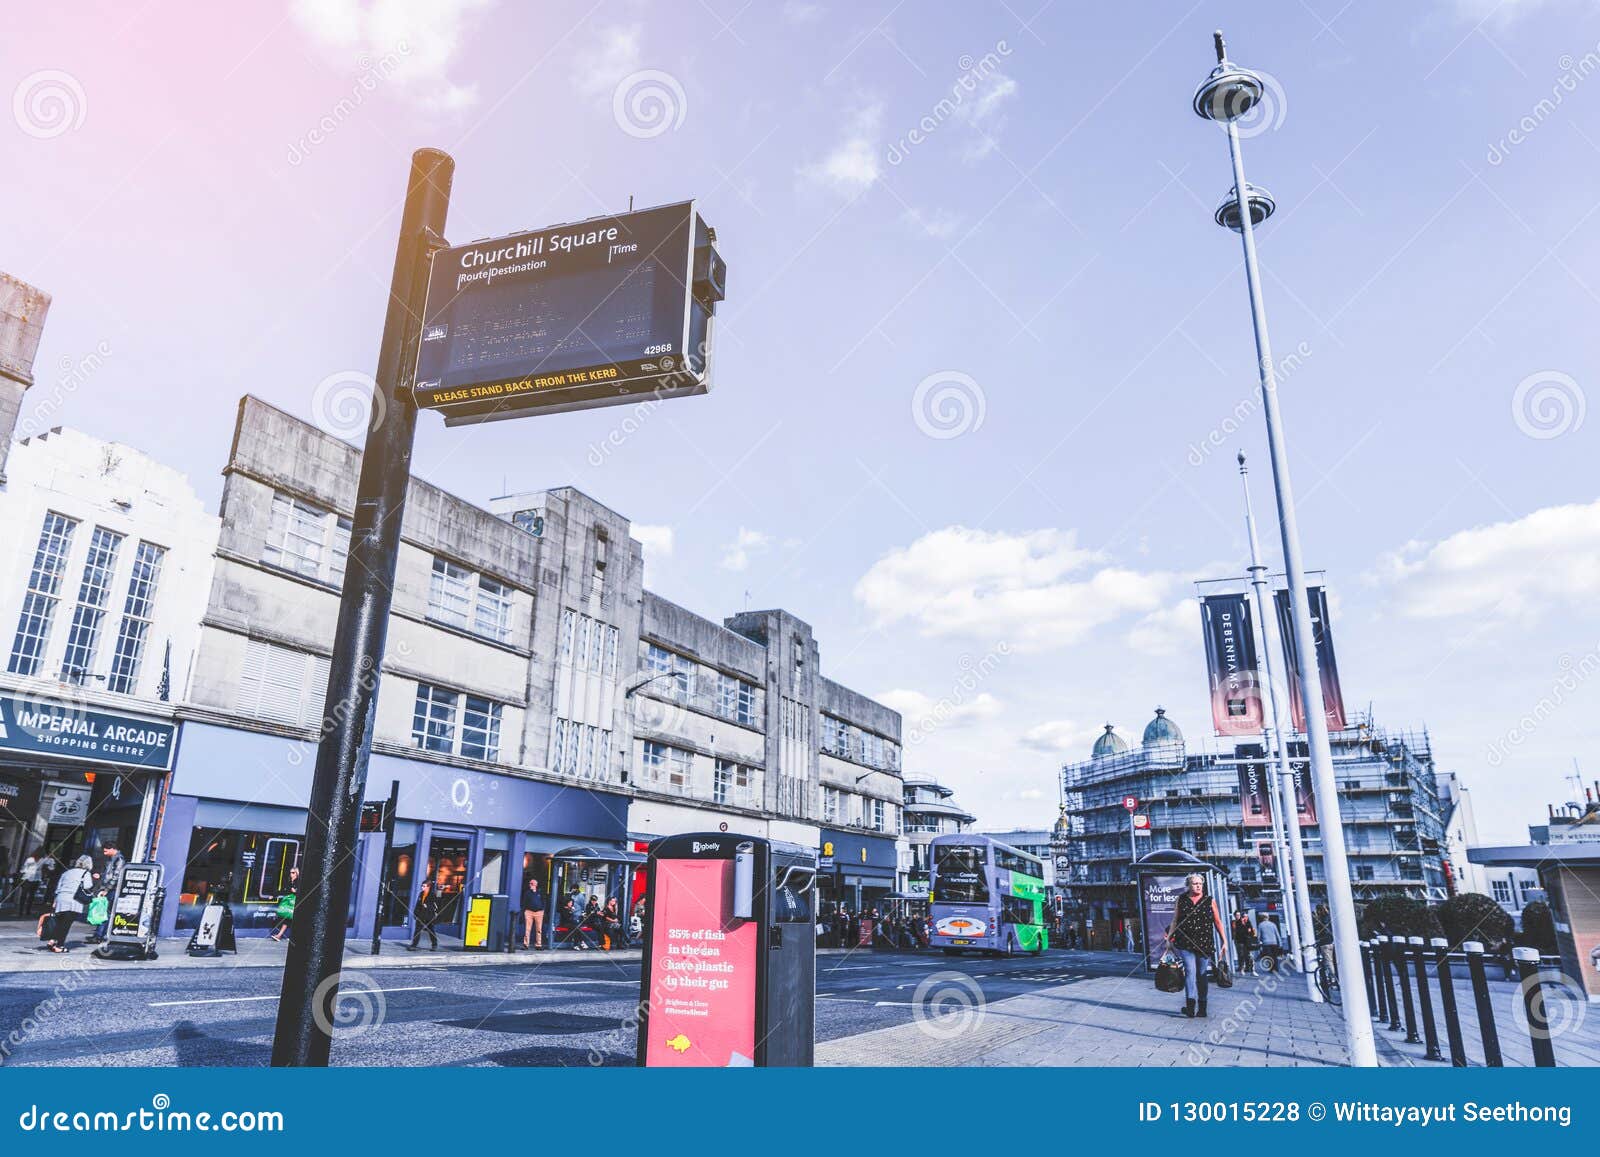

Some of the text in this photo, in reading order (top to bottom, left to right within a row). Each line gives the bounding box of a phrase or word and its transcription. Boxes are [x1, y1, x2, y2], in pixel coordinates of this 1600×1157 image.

[461, 226, 618, 268] Churchill Square
[613, 243, 638, 256] Time
[460, 260, 547, 283] Route Destination
[644, 343, 672, 355] 42968
[433, 368, 618, 403] PLEASE STAND BACK FROM THE KERB
[1222, 613, 1239, 690] DEBENHAMS
[16, 710, 168, 748] IMPERIAL ARCADE
[37, 734, 145, 757] SHOPPING CENTRE
[692, 841, 720, 853] Bigbelly
[1149, 885, 1172, 893] More
[1150, 894, 1162, 902] for
[668, 928, 725, 941] 35% of fish
[668, 943, 720, 956] in the sea
[667, 959, 735, 973] have plastic
[680, 975, 708, 988] their
[709, 978, 729, 991] gut
